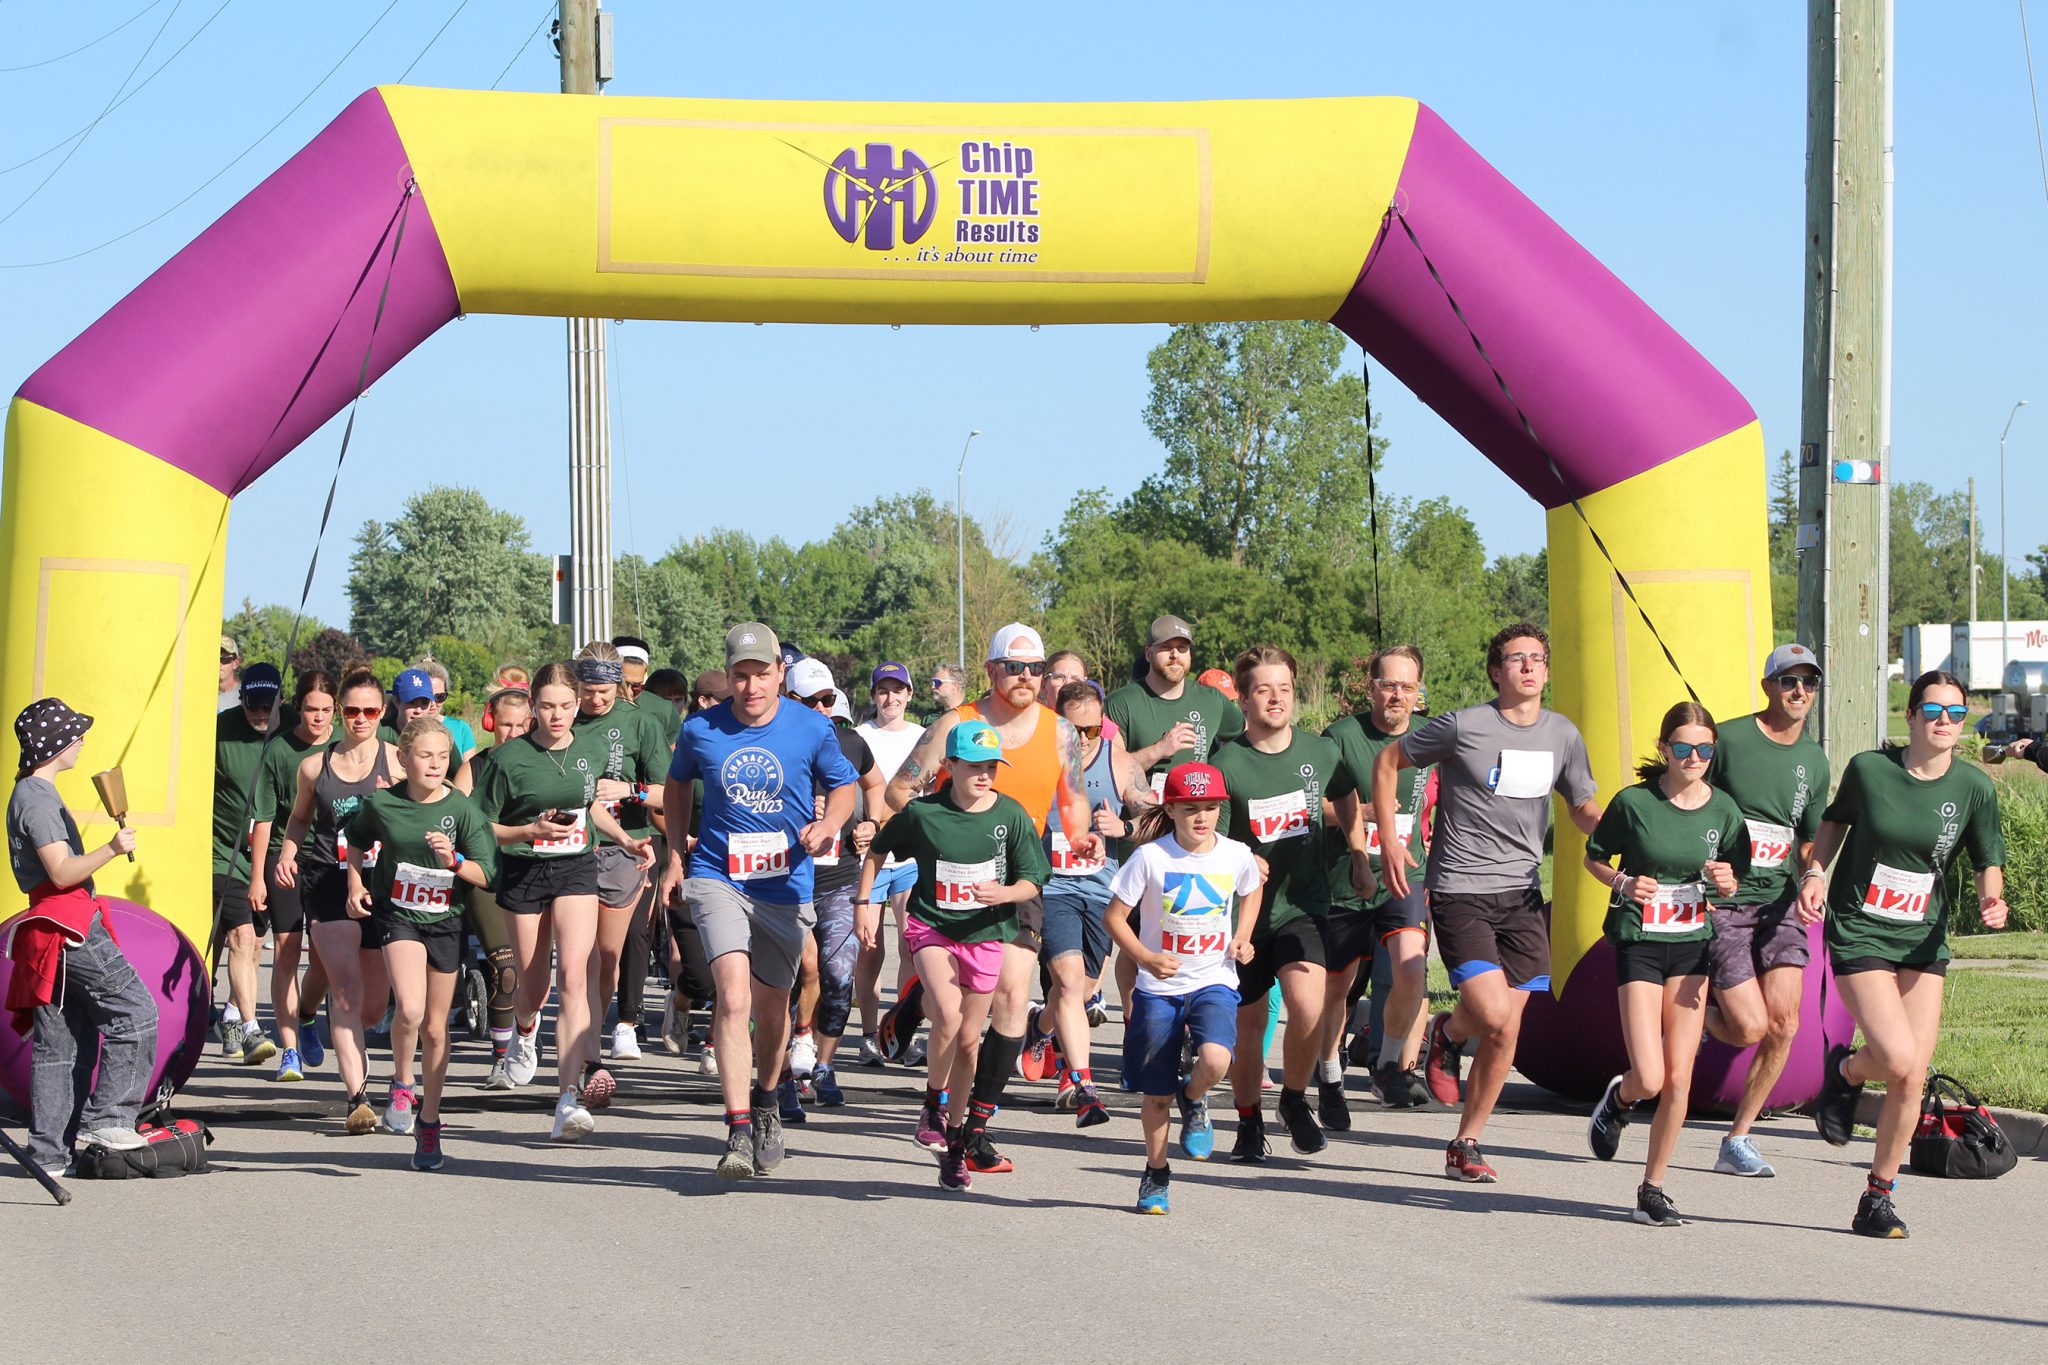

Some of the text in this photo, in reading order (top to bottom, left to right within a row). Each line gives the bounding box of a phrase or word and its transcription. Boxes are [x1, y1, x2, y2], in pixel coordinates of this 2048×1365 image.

[961, 142, 1033, 178] Chip
[957, 179, 1039, 216] TIME
[956, 220, 1040, 243] Results
[916, 247, 939, 262] it's
[944, 248, 993, 263] about
[999, 249, 1038, 263] time
[727, 754, 777, 779] CHARACTER
[726, 783, 769, 807] Run
[1189, 783, 1206, 797] 23
[751, 800, 783, 814] 2023
[1256, 809, 1304, 839] 125
[735, 848, 786, 876] 160
[1754, 840, 1787, 862] 62
[400, 879, 448, 907] 165
[943, 880, 975, 905] 15
[1874, 884, 1927, 916] 120
[1650, 899, 1698, 927] 121
[1169, 930, 1222, 957] 142
